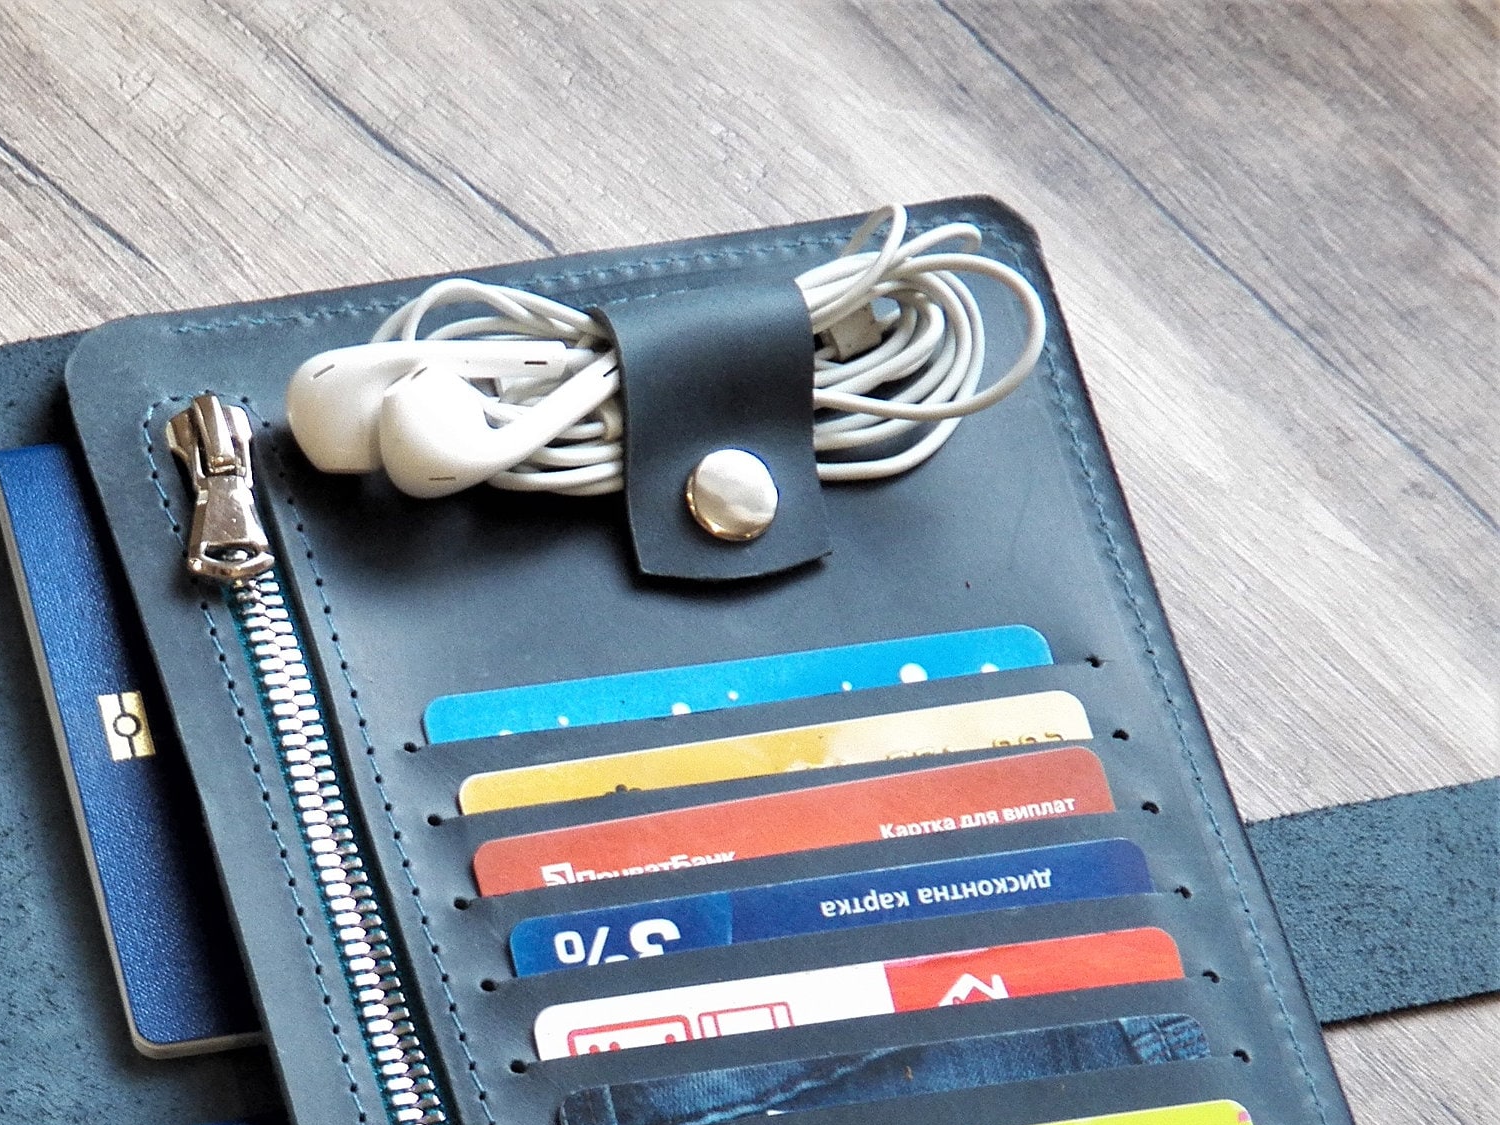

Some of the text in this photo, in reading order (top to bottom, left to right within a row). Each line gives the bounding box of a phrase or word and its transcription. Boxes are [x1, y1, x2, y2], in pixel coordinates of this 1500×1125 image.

[878, 797, 1076, 840] Картка для виплат
[820, 889, 910, 918] картка
